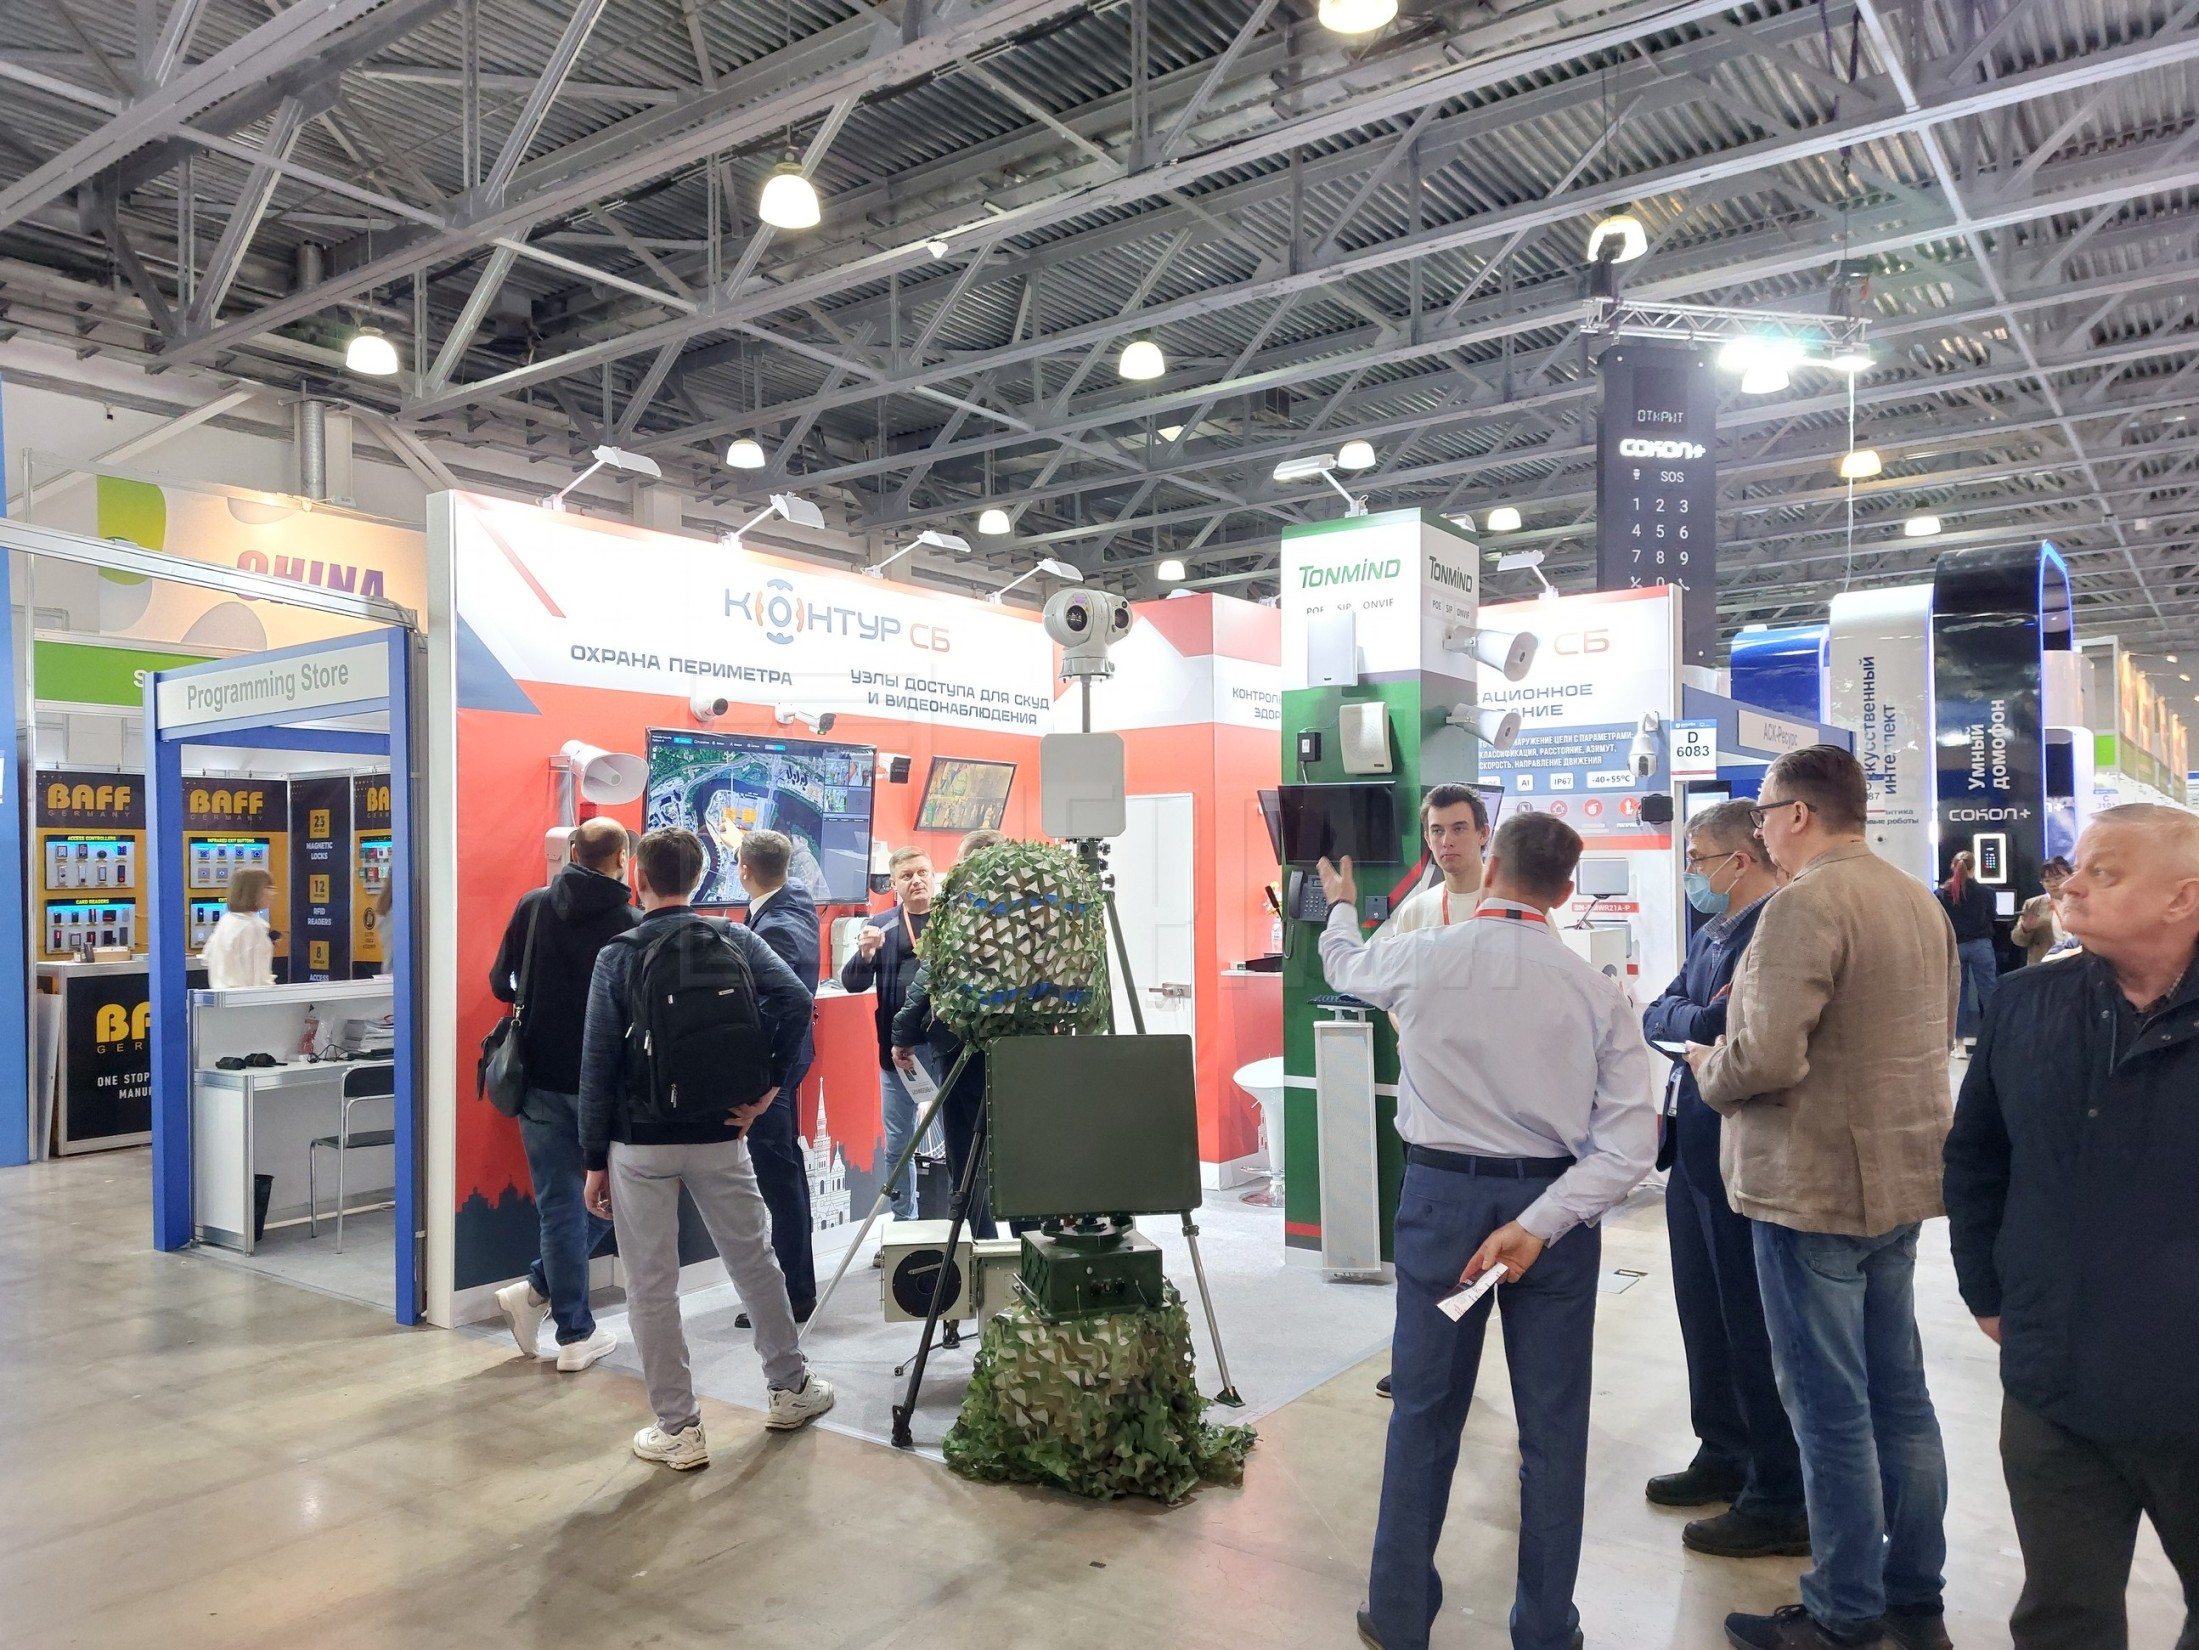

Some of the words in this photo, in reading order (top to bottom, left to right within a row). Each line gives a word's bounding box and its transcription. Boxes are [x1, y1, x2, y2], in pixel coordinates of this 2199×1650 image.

[1660, 471, 1685, 483] SOS
[1633, 497, 1640, 511] 1
[1655, 499, 1665, 513] 2
[1680, 500, 1689, 513] 3
[1632, 523, 1641, 537] 4
[1656, 524, 1665, 538] 5
[1680, 525, 1689, 539] 6
[1632, 550, 1641, 563] 7
[1656, 551, 1665, 564] 8
[1680, 551, 1689, 565] 9
[1363, 598, 1394, 610] ONVIF
[1432, 599, 1442, 611] POE
[1445, 604, 1453, 614] SIP
[909, 623, 950, 653] СБ
[1554, 628, 1610, 655] СБ
[570, 644, 661, 671] ОХРАНА
[669, 657, 792, 686] ПЕРИМЕТРА
[187, 670, 296, 712] Programming
[301, 663, 349, 692] Store
[850, 669, 899, 688] УЗЛЫ
[905, 677, 975, 699] ДОСТУПА
[980, 689, 1010, 704] ДЛЯ
[1014, 694, 1050, 711] СКУД
[1482, 683, 1593, 703] АЦИОННОЕ
[868, 692, 879, 705] И
[885, 694, 1037, 725] ВИДЕОНАБЛЮДЕНИЯ
[1687, 731, 1698, 743] D
[1676, 745, 1710, 757] 6083
[1966, 724, 1986, 790] Умный
[47, 783, 131, 810] BAFF
[189, 789, 264, 814] BAFF
[47, 810, 131, 818] GERMANY
[313, 815, 325, 828] 23
[306, 842, 333, 850] MAGNETIC
[310, 852, 328, 860] LOCKS
[314, 880, 325, 893] 12
[313, 907, 326, 915] RFID
[307, 918, 332, 926] READERS
[316, 946, 321, 959] 8
[97, 1075, 118, 1087] ONE
[124, 1072, 150, 1084] STOP
